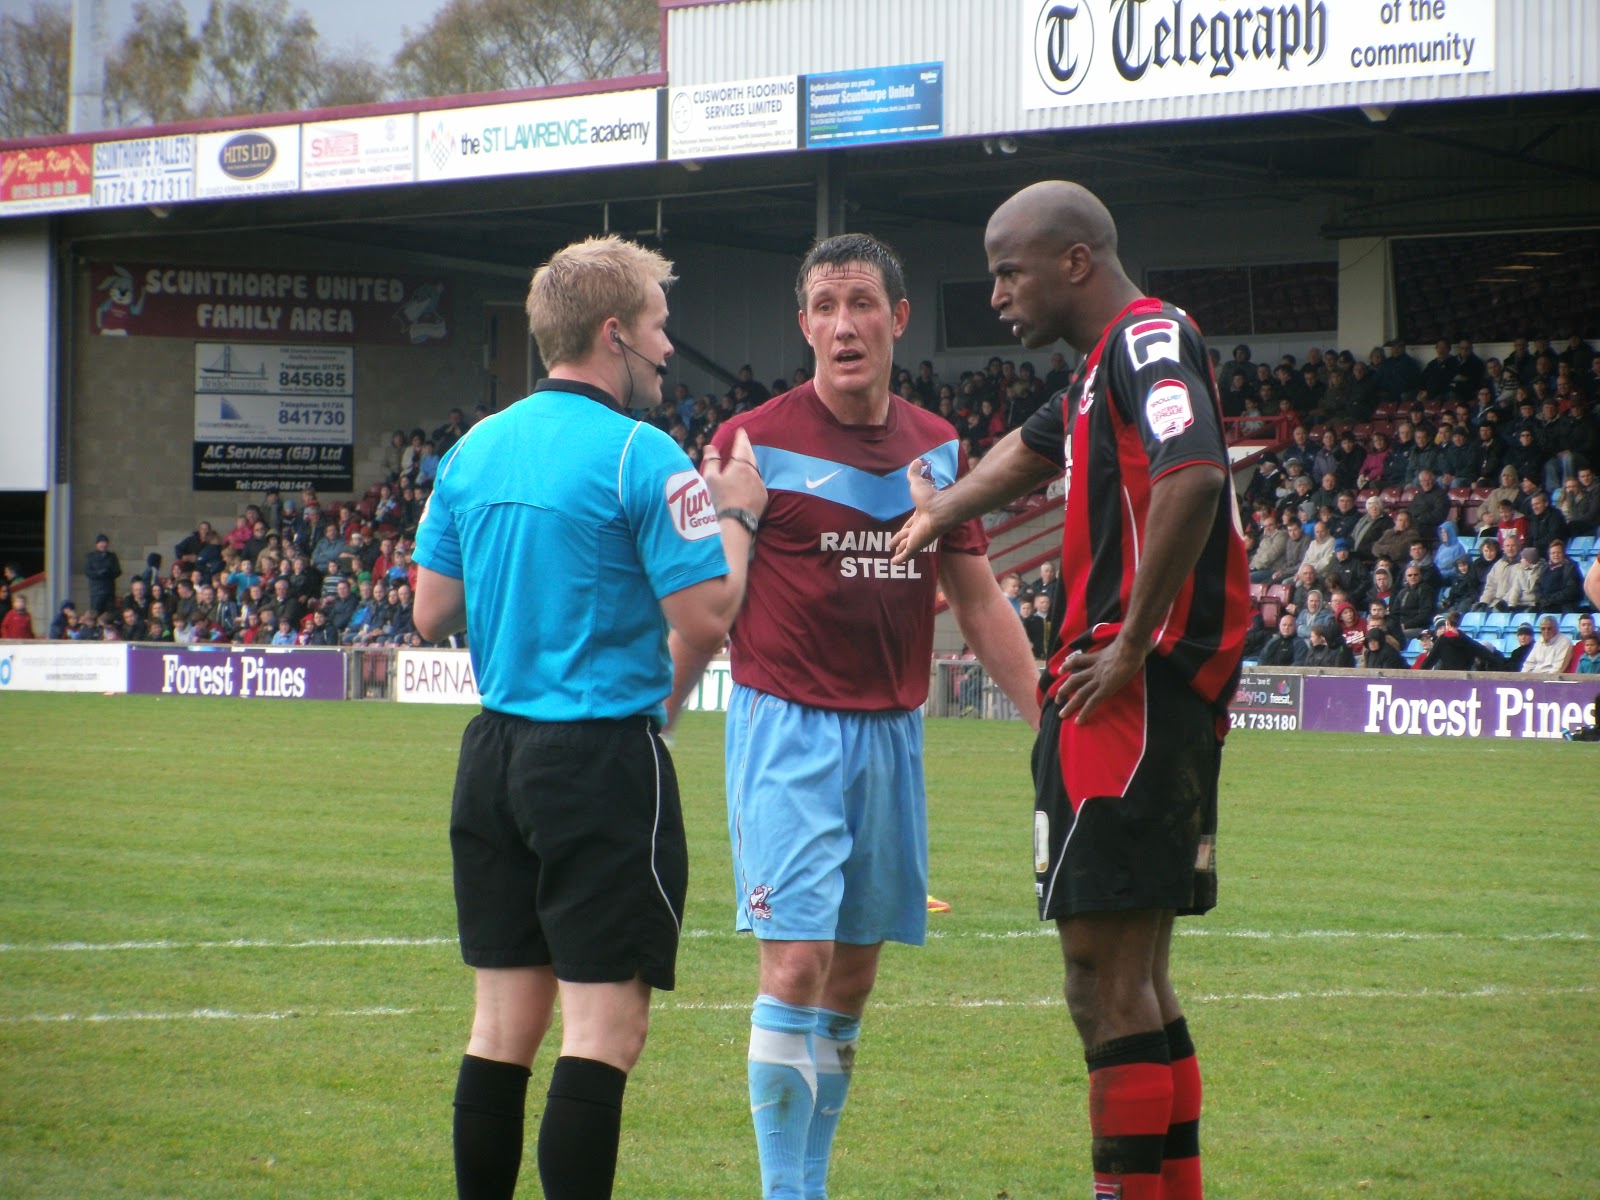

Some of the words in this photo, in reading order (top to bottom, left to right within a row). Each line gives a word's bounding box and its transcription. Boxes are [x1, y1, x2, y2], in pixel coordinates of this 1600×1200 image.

[1380, 0, 1402, 24] of
[1410, 0, 1445, 21] the
[1109, 0, 1328, 81] Telegraph
[1350, 32, 1475, 68] community
[693, 87, 744, 104] CUSWORTH
[747, 81, 795, 99] FLOORING
[810, 92, 840, 109] Sponsor
[841, 86, 887, 104] Scunthorpe
[888, 83, 915, 99] United
[705, 103, 745, 119] SERVICES
[748, 99, 783, 115] LIMITED
[461, 133, 480, 155] the
[482, 127, 502, 153] ST
[504, 118, 588, 150] LAWRENCE
[590, 118, 651, 145] academy
[251, 143, 271, 161] LTD
[95, 181, 135, 206] 01724
[141, 177, 191, 202] 271311
[145, 269, 308, 299] SCUNTHORPE
[316, 276, 404, 302] UNITED
[196, 304, 284, 330] FAMILY
[290, 308, 354, 333] AREA
[279, 371, 345, 387] 845685
[279, 409, 345, 425] 841730
[204, 445, 223, 459] AC
[226, 445, 283, 460] Services
[286, 446, 316, 461] (GB)
[320, 447, 343, 460] Ltd
[235, 480, 250, 489] Tel:
[820, 531, 939, 553] RAINM
[840, 557, 921, 579] STEEL
[162, 654, 233, 695] Forest
[240, 656, 306, 697] Pines
[1249, 713, 1297, 730] 733180
[1364, 685, 1482, 737] Forest
